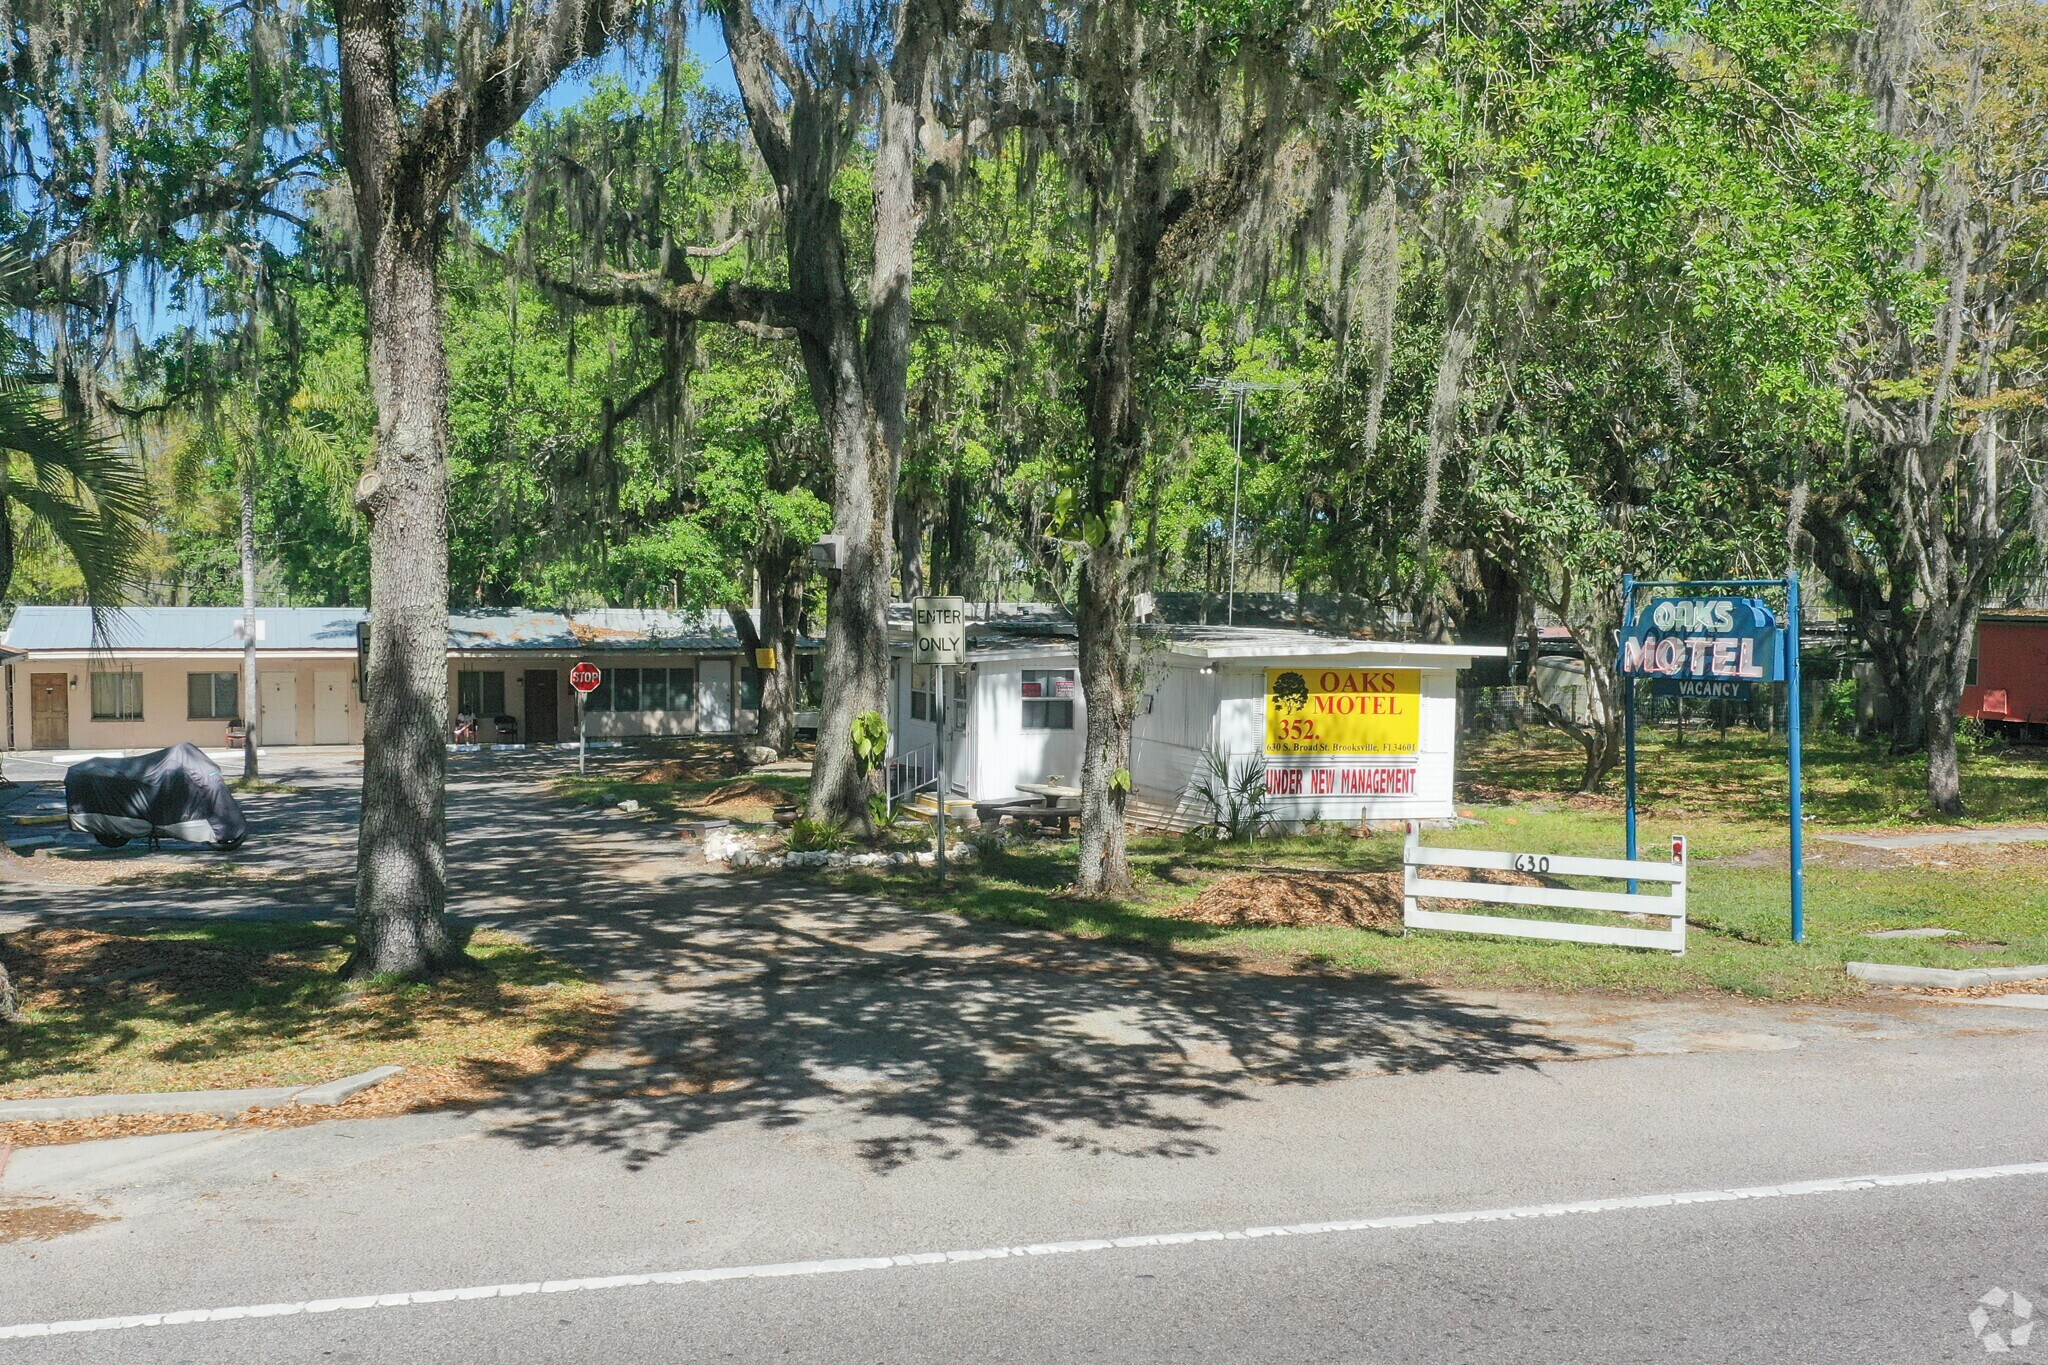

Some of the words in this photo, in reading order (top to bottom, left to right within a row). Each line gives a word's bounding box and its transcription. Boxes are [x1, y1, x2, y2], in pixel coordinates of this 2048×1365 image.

[917, 610, 961, 624] ENTER
[1654, 600, 1734, 633] OAKS
[919, 637, 960, 652] ONLY
[1624, 636, 1763, 678] MOTEL
[572, 671, 598, 683] STOP
[1320, 671, 1396, 693] OAKS
[1679, 681, 1739, 697] VACANCY
[1313, 695, 1402, 715] MOTEL
[1278, 719, 1320, 740] 352.
[1266, 743, 1281, 752] 630
[1283, 743, 1291, 752] S.
[1293, 743, 1318, 752] Broad
[1320, 743, 1330, 752] St.
[1332, 743, 1379, 752] Brooksville,
[1393, 743, 1416, 752] 34601
[1266, 769, 1303, 795] UNDER
[1311, 769, 1336, 795] NEW
[1341, 768, 1416, 794] MANAGEMENT
[1514, 854, 1550, 873] 630
